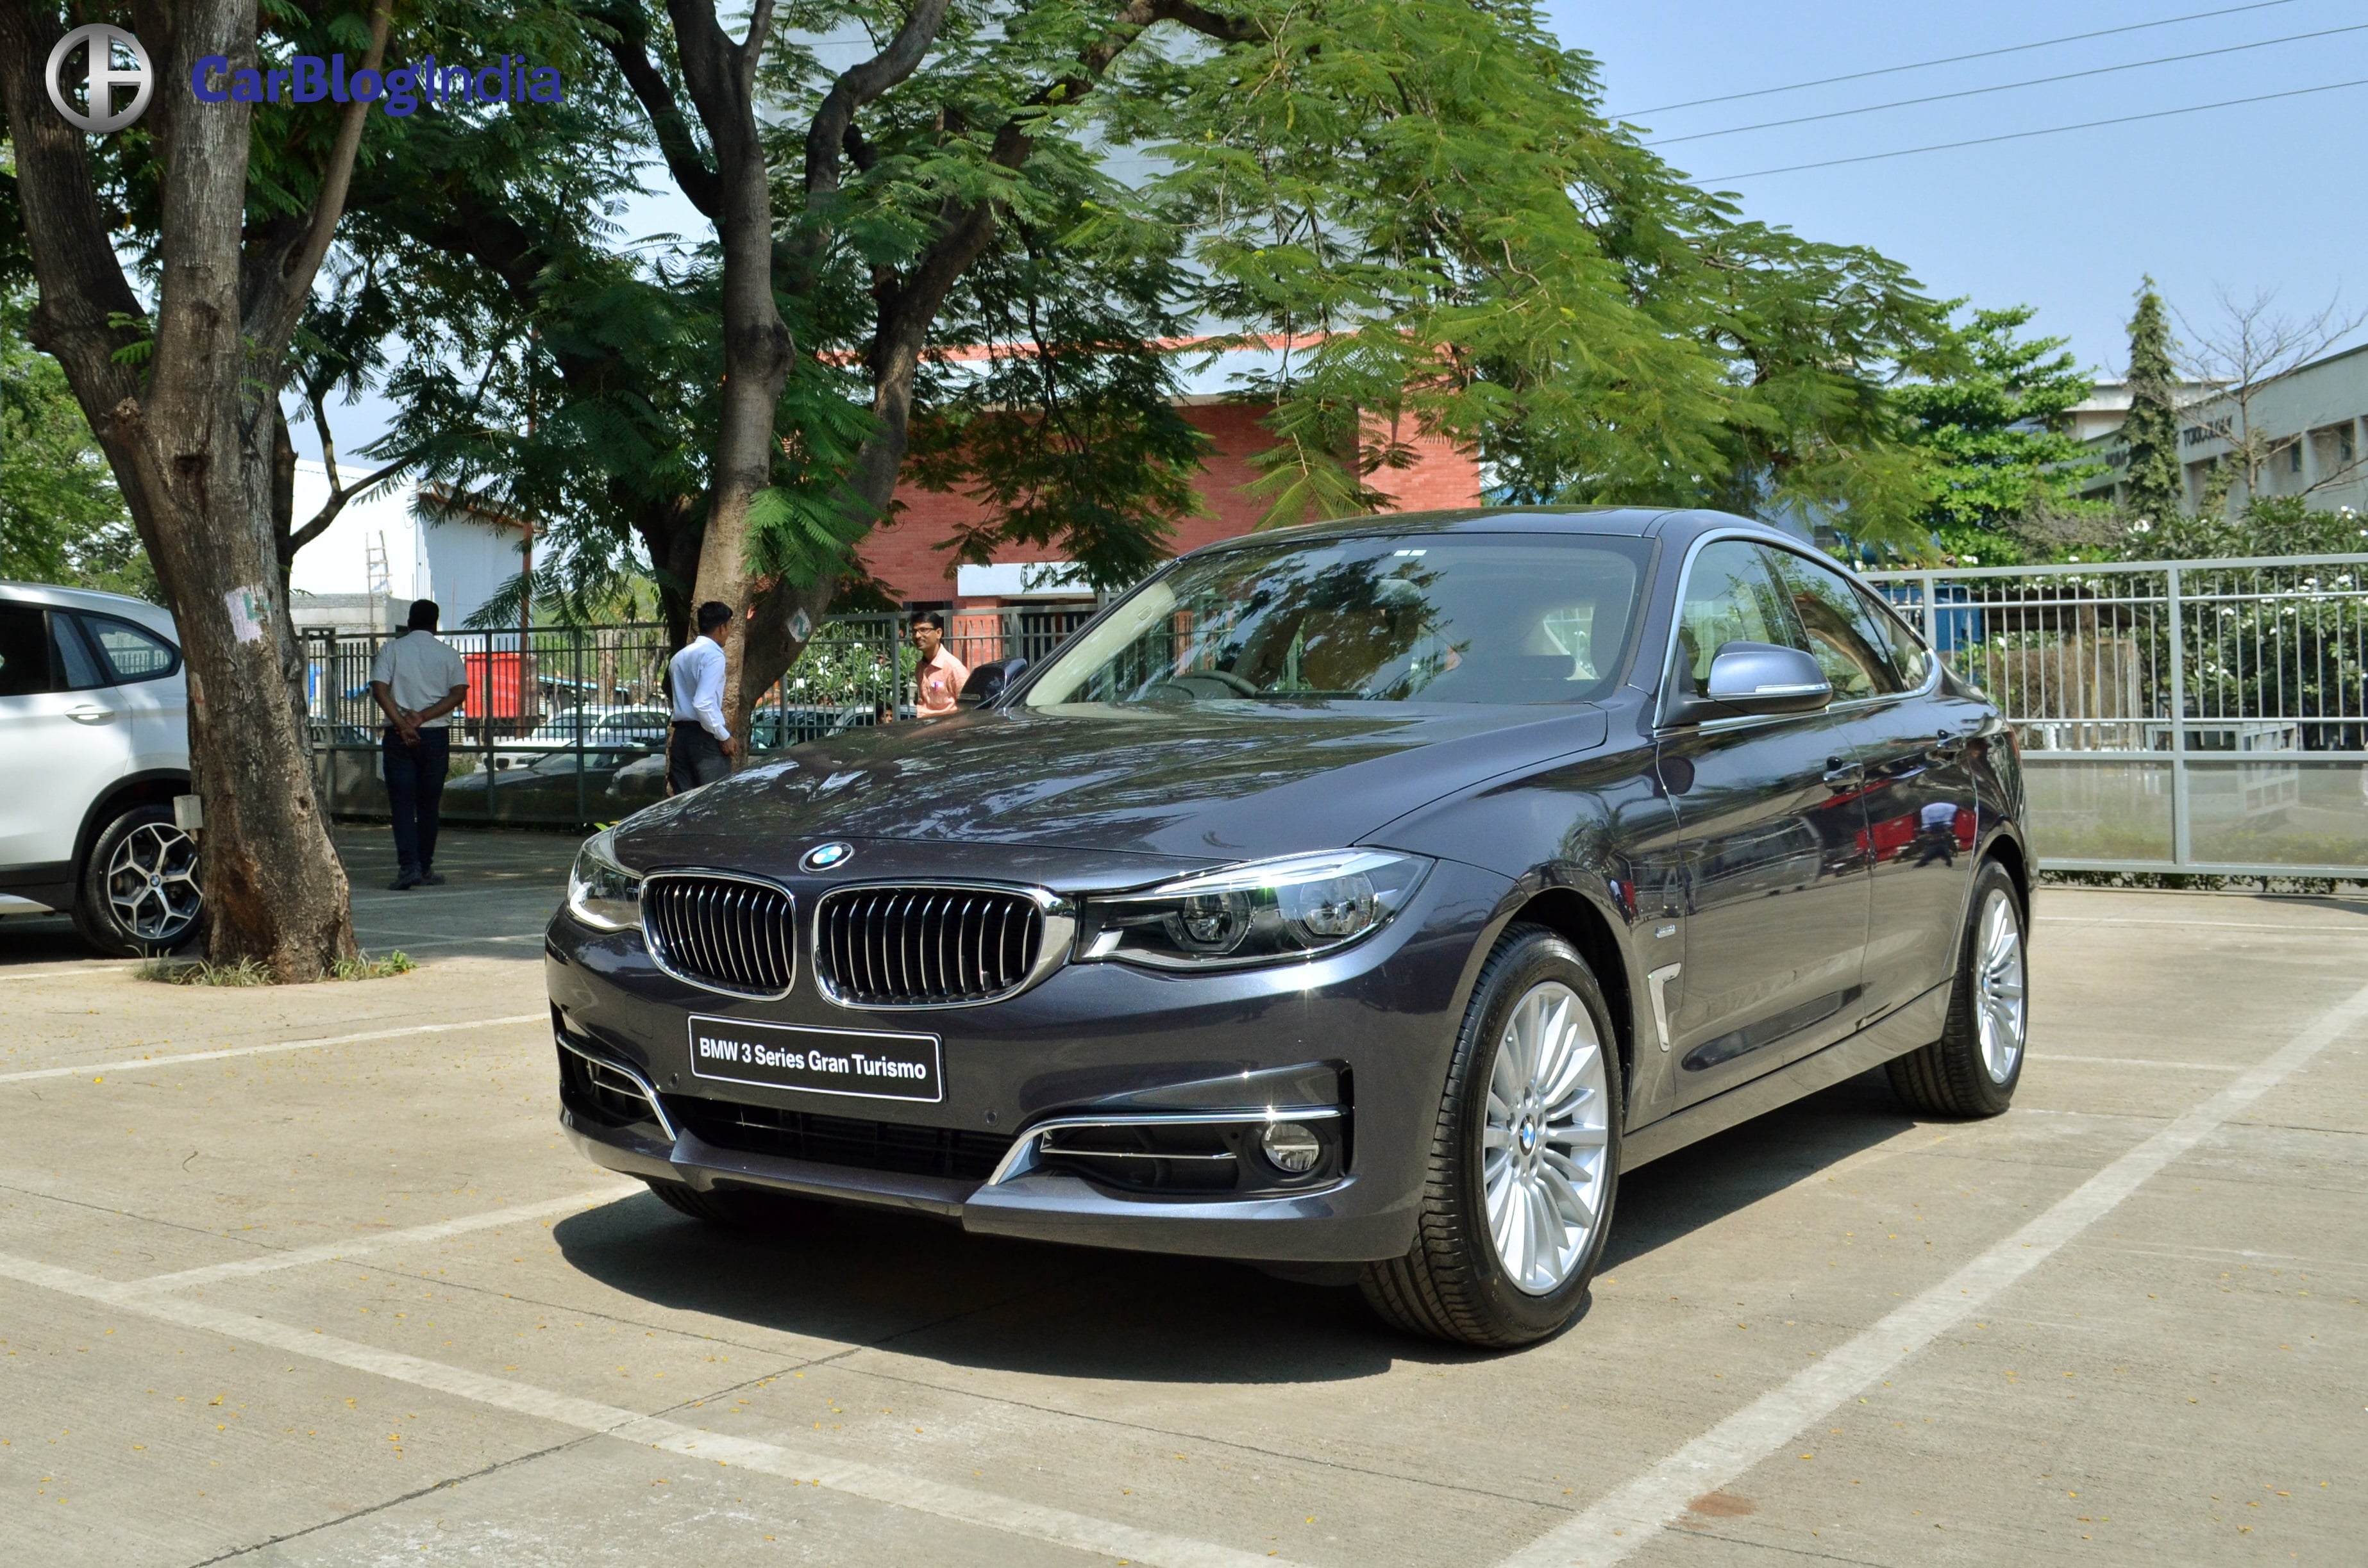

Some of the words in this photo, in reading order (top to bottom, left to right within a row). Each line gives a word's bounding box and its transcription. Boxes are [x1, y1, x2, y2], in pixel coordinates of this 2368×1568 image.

[700, 1037, 738, 1063] BMW
[742, 1044, 752, 1063] 3
[755, 1045, 805, 1069] Series
[809, 1050, 850, 1074] Gran
[851, 1053, 927, 1080] Turismo
